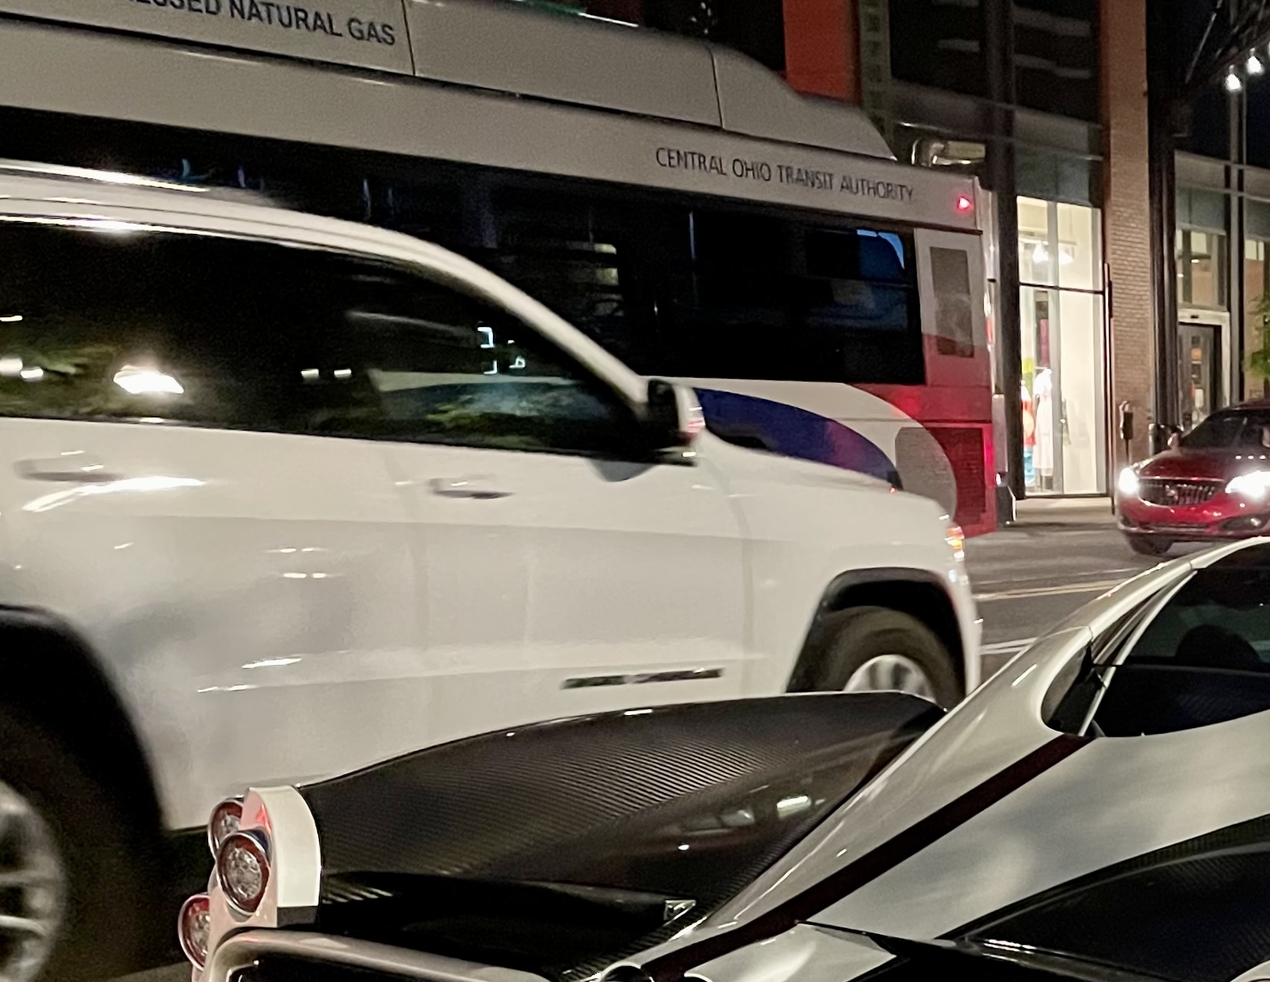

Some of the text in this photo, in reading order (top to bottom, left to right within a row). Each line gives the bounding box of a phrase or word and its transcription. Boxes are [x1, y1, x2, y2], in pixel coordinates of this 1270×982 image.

[229, 0, 343, 37] NATURAL
[347, 18, 396, 46] GAS
[656, 147, 914, 201] CENTRAL OHIO TRANSIT AUTHORITY
